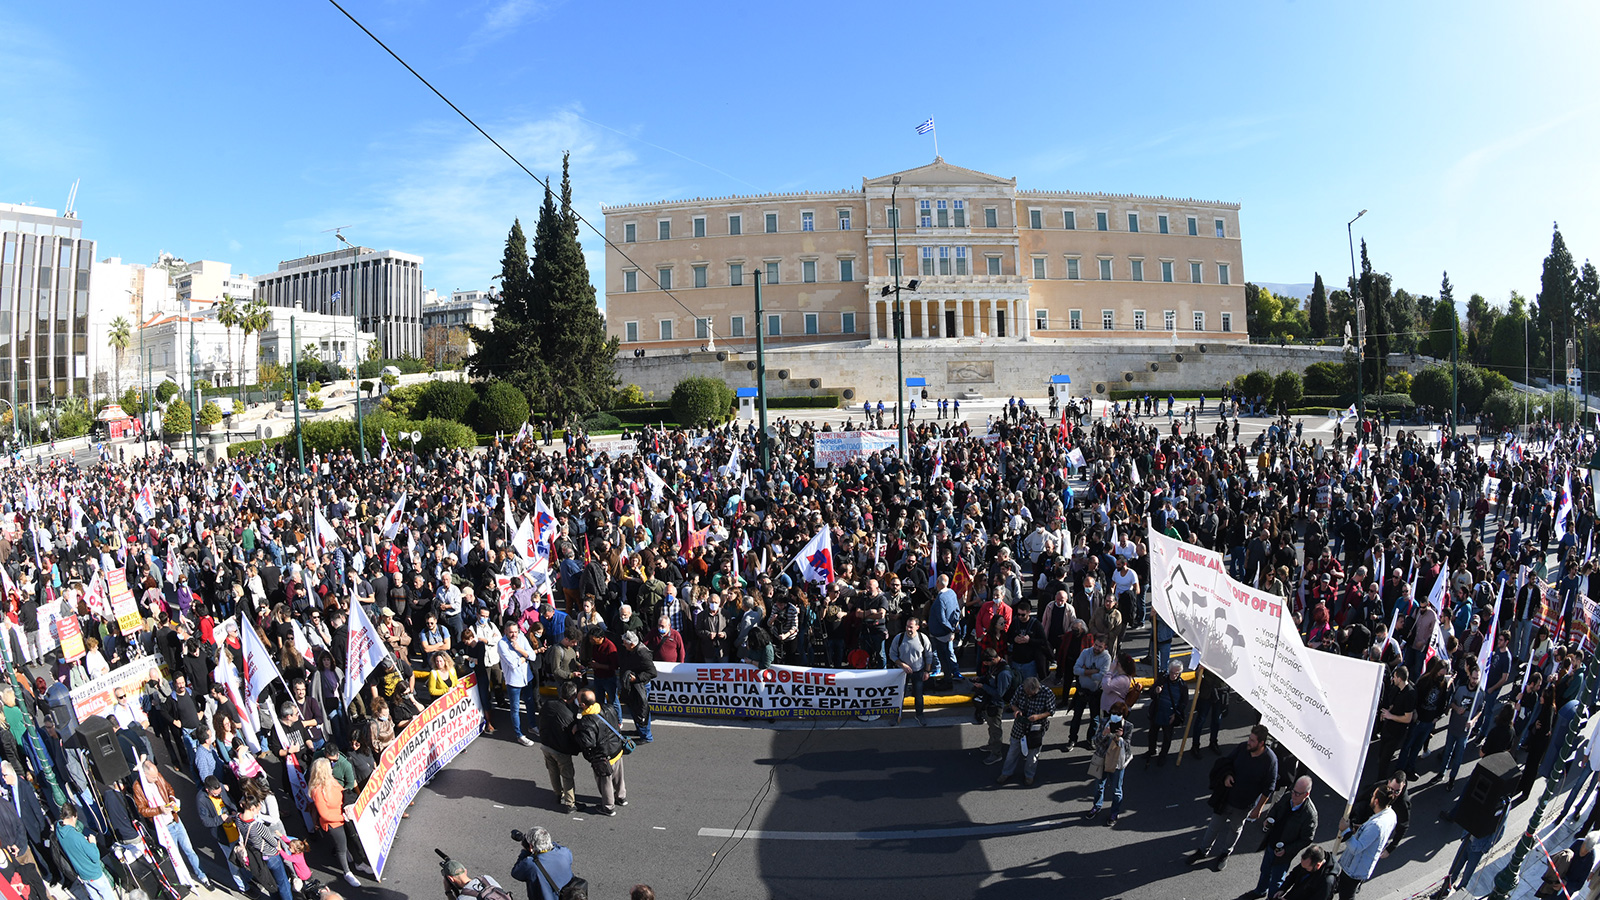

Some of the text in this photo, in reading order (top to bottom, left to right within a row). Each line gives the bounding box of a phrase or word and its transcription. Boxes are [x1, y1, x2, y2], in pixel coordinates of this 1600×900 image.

[1178, 547, 1207, 567] THINK
[1232, 587, 1250, 607] OUT
[1251, 597, 1267, 612] OF
[650, 680, 899, 697] ΝΑΠΤΥΞΗ ΓΙΑ ΤΑ ΚΕΡΔΗ ΤΟΥΣ
[697, 668, 836, 685] ΞΕΣΗΚΩΘΕΙΤΕ
[648, 693, 893, 709] ΕΞΑΘΛΙΩΝΟΥΝ ΤΟΥΣ ΕΡΓΑΤΕΣ
[649, 704, 683, 713] ΝΔΙΚΑΤΟ
[686, 706, 736, 715] ΕΠΙΣΙΤΙΣΜΟΥ
[744, 709, 790, 717] ΤΟΥΡΙΣΜΟΥ
[866, 708, 900, 716] ΑΤΤΙΚΗΣ
[1305, 695, 1325, 713] στους
[395, 726, 430, 771] ΣΥΜΒΑΣΗ
[432, 715, 447, 731] ΓΙΑ
[398, 720, 422, 752] ΔΙΚΕΣ
[422, 700, 443, 724] ΜΑΣ
[405, 747, 426, 774] στους
[428, 715, 463, 751] ΜΙΣΘΟΥΣ
[406, 741, 445, 788] ΕΡΓΑΣΙΜΟΥ
[448, 716, 480, 747] ΧΡΟΝΟΥ
